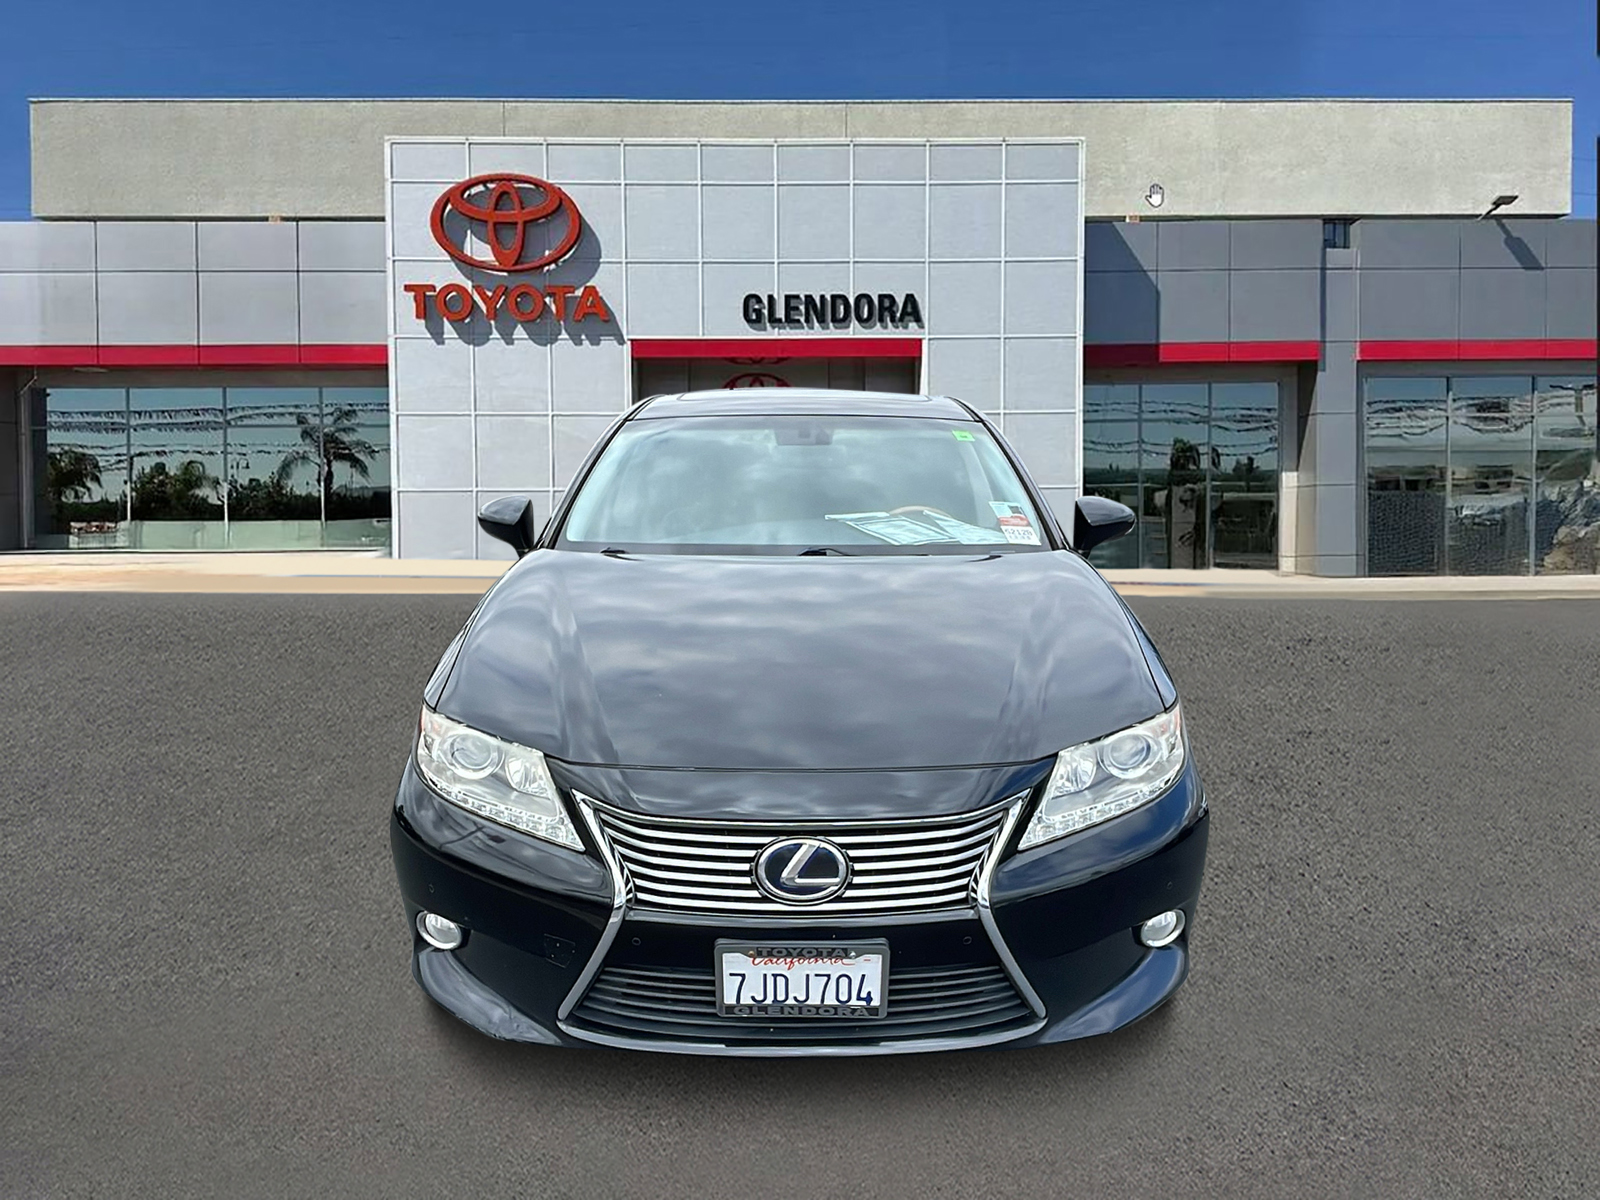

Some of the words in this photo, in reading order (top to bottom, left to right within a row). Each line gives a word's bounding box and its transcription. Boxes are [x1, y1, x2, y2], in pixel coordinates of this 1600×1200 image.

[404, 283, 610, 322] TOYOTA
[743, 293, 923, 324] GLENDORA
[758, 948, 846, 957] TOYOTA
[729, 973, 873, 1006] 7JDJ704
[734, 1006, 870, 1017] GLENDORA
